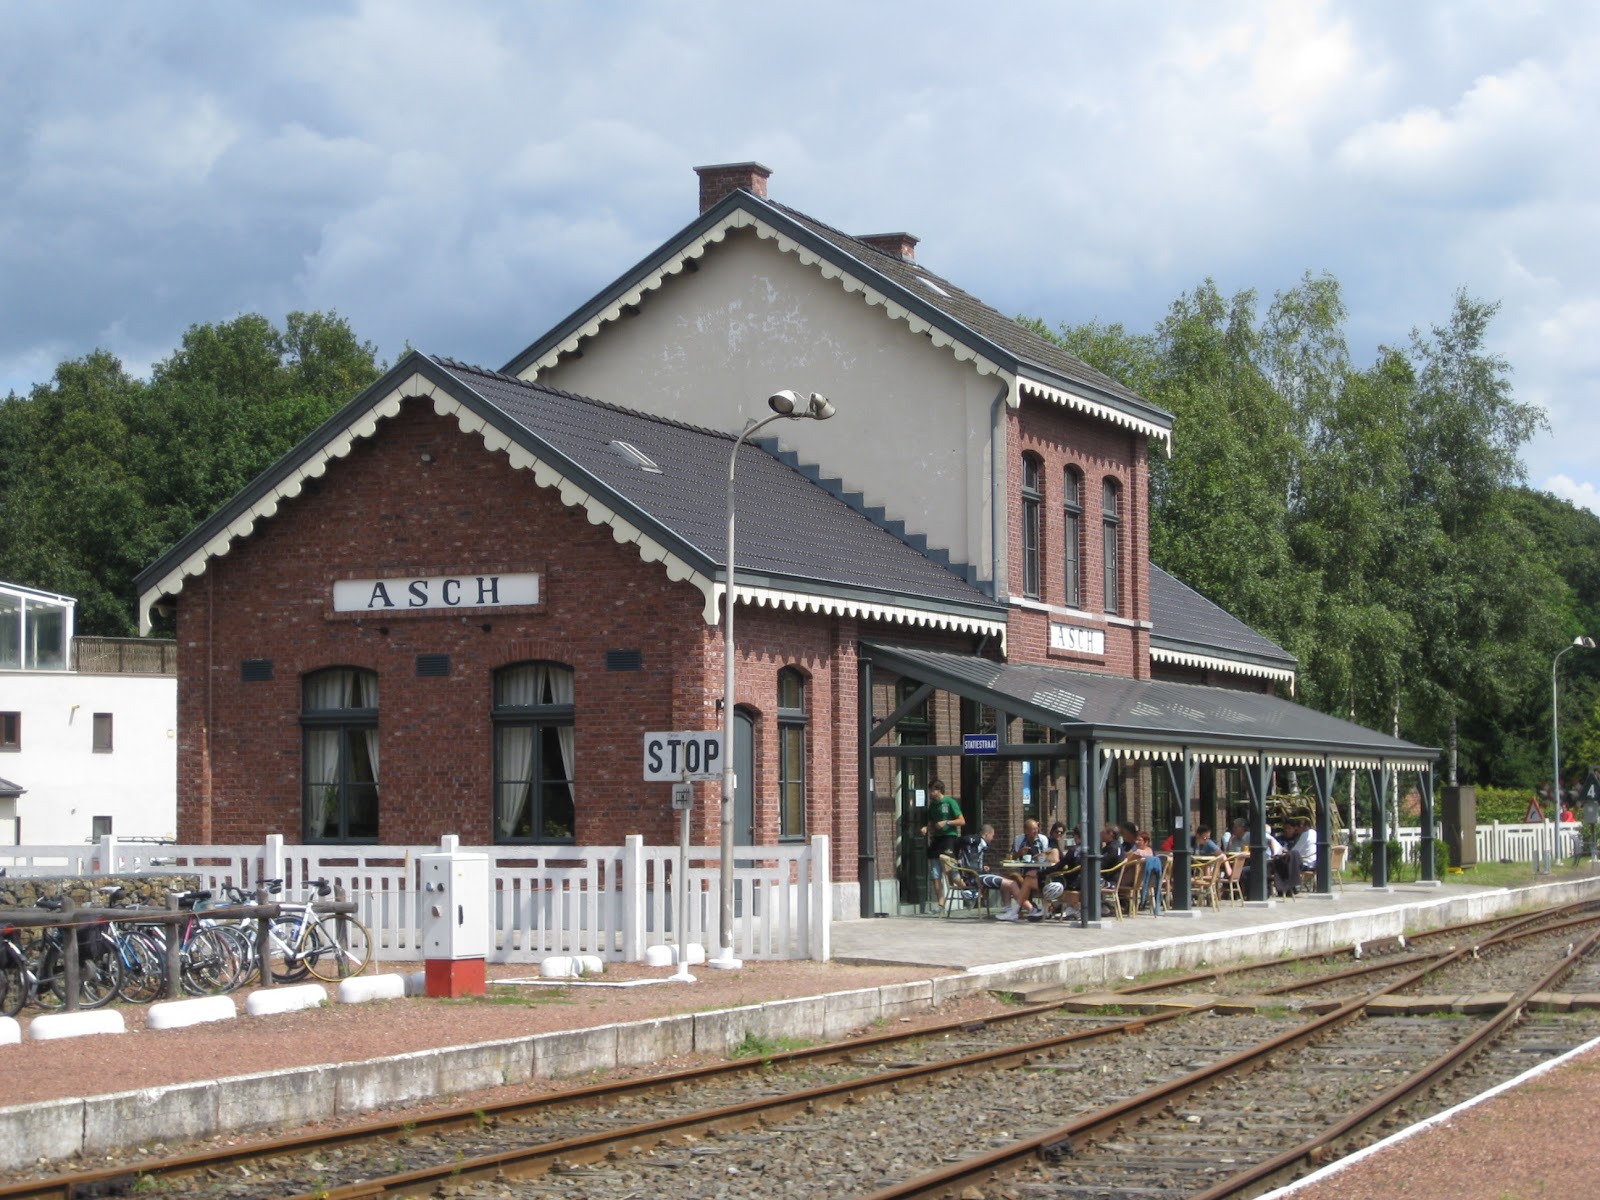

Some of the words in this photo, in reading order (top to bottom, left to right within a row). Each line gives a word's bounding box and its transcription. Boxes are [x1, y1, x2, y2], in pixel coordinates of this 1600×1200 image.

[367, 577, 500, 608] ASCH
[1057, 625, 1093, 652] ASCH
[648, 739, 719, 773] STOP
[964, 740, 997, 749] STATIESTRAAT
[1587, 784, 1596, 798] 4
